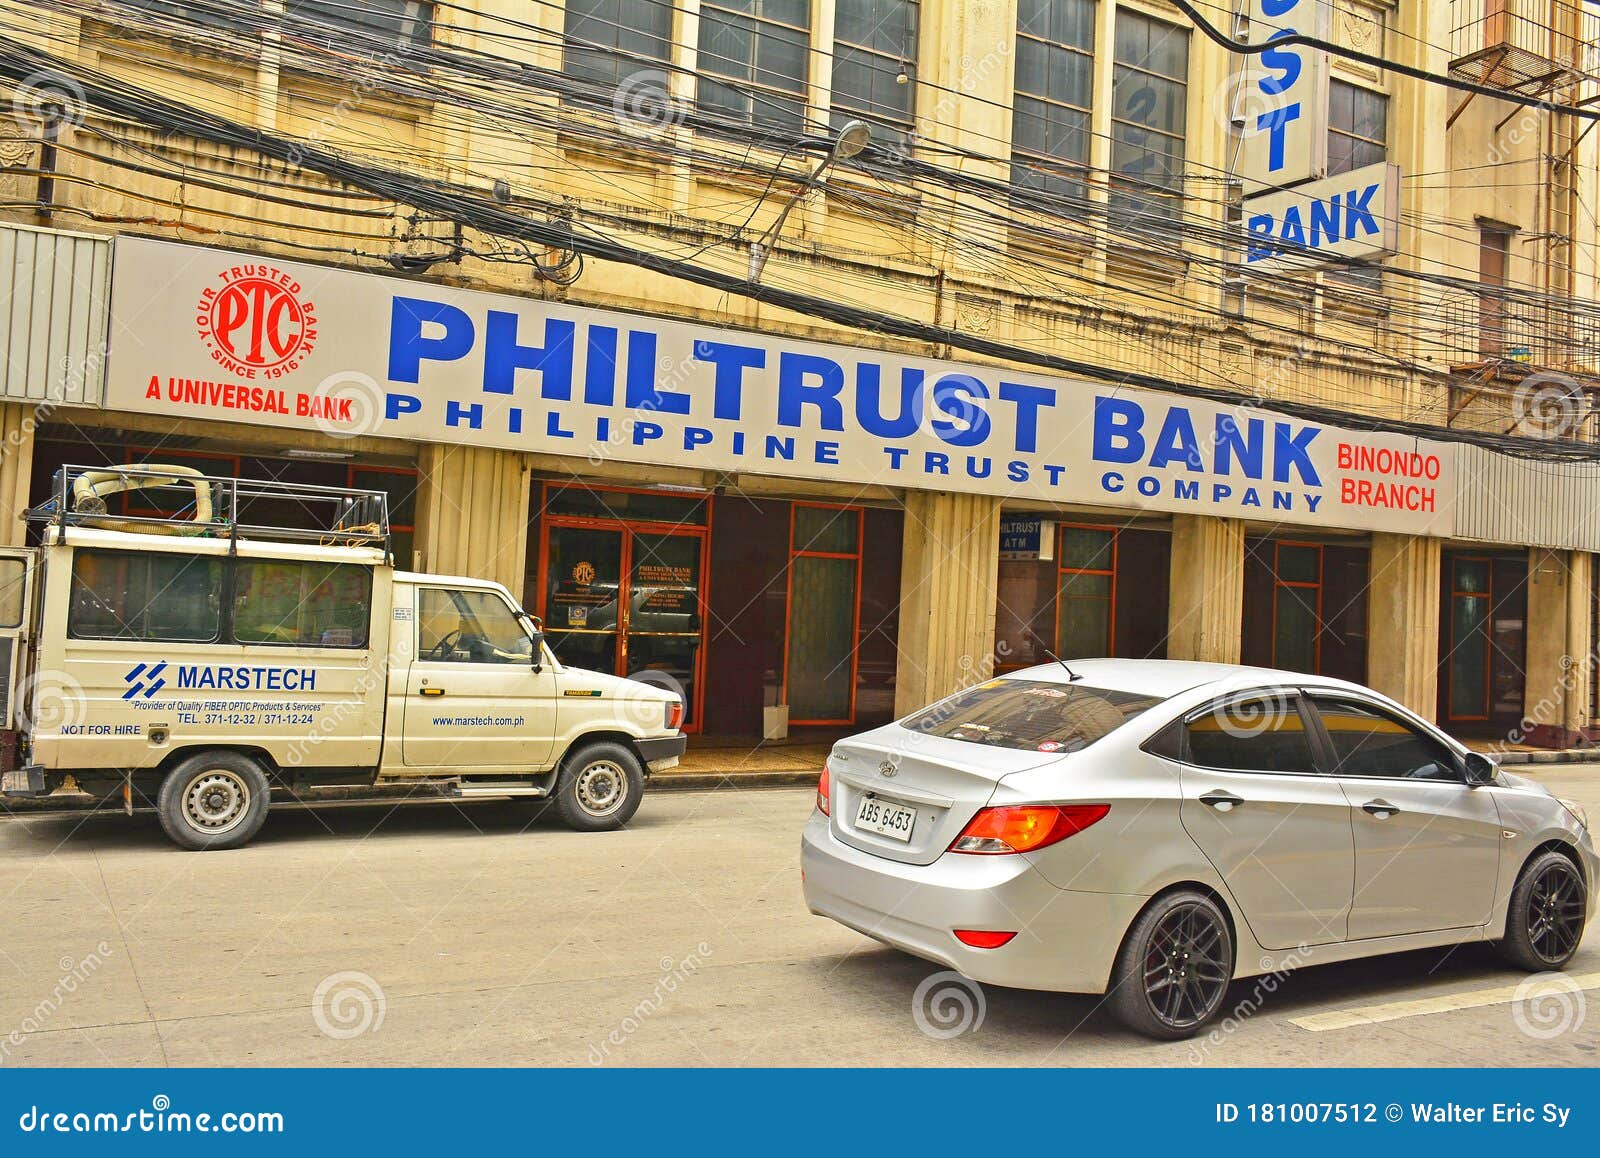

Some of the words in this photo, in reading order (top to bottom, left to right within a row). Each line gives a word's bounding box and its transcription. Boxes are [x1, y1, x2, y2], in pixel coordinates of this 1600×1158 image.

[1257, 0, 1302, 172] ST
[1247, 184, 1380, 262] BANK
[196, 287, 217, 341] YOUR
[218, 264, 301, 295] TRUSTED
[302, 302, 318, 356] BANK
[216, 280, 300, 364] PTC
[211, 349, 257, 379] SINCE
[263, 359, 299, 380] 1916
[145, 375, 161, 400] A
[168, 377, 289, 415] UNIVERSAL
[296, 393, 353, 422] BANK
[387, 295, 1056, 454] PHILTRUST
[1092, 396, 1323, 487] BANK
[385, 393, 839, 465] PHILIPPINE
[884, 447, 1066, 487] TRUST
[1101, 471, 1323, 513] COMPANY
[1337, 443, 1440, 480] BINONDO
[1341, 478, 1435, 512] BRANCH
[1004, 537, 1027, 548] ATM
[177, 666, 316, 690] MARSTECH
[167, 701, 175, 710] of
[177, 701, 203, 712] Quality
[204, 701, 227, 711] FIBER
[228, 702, 251, 711] OPTIC
[253, 702, 284, 711] Products
[285, 702, 291, 711] &
[177, 713, 201, 724] TEL.
[205, 714, 255, 724] 371-12-32
[265, 714, 313, 724] 371-12-24
[432, 716, 524, 728] www.marstech.com.ph
[61, 725, 85, 735] NOT
[88, 725, 111, 735] FOR
[114, 725, 140, 735] HIRE
[860, 803, 880, 823] ABS
[882, 808, 912, 832] 6453
